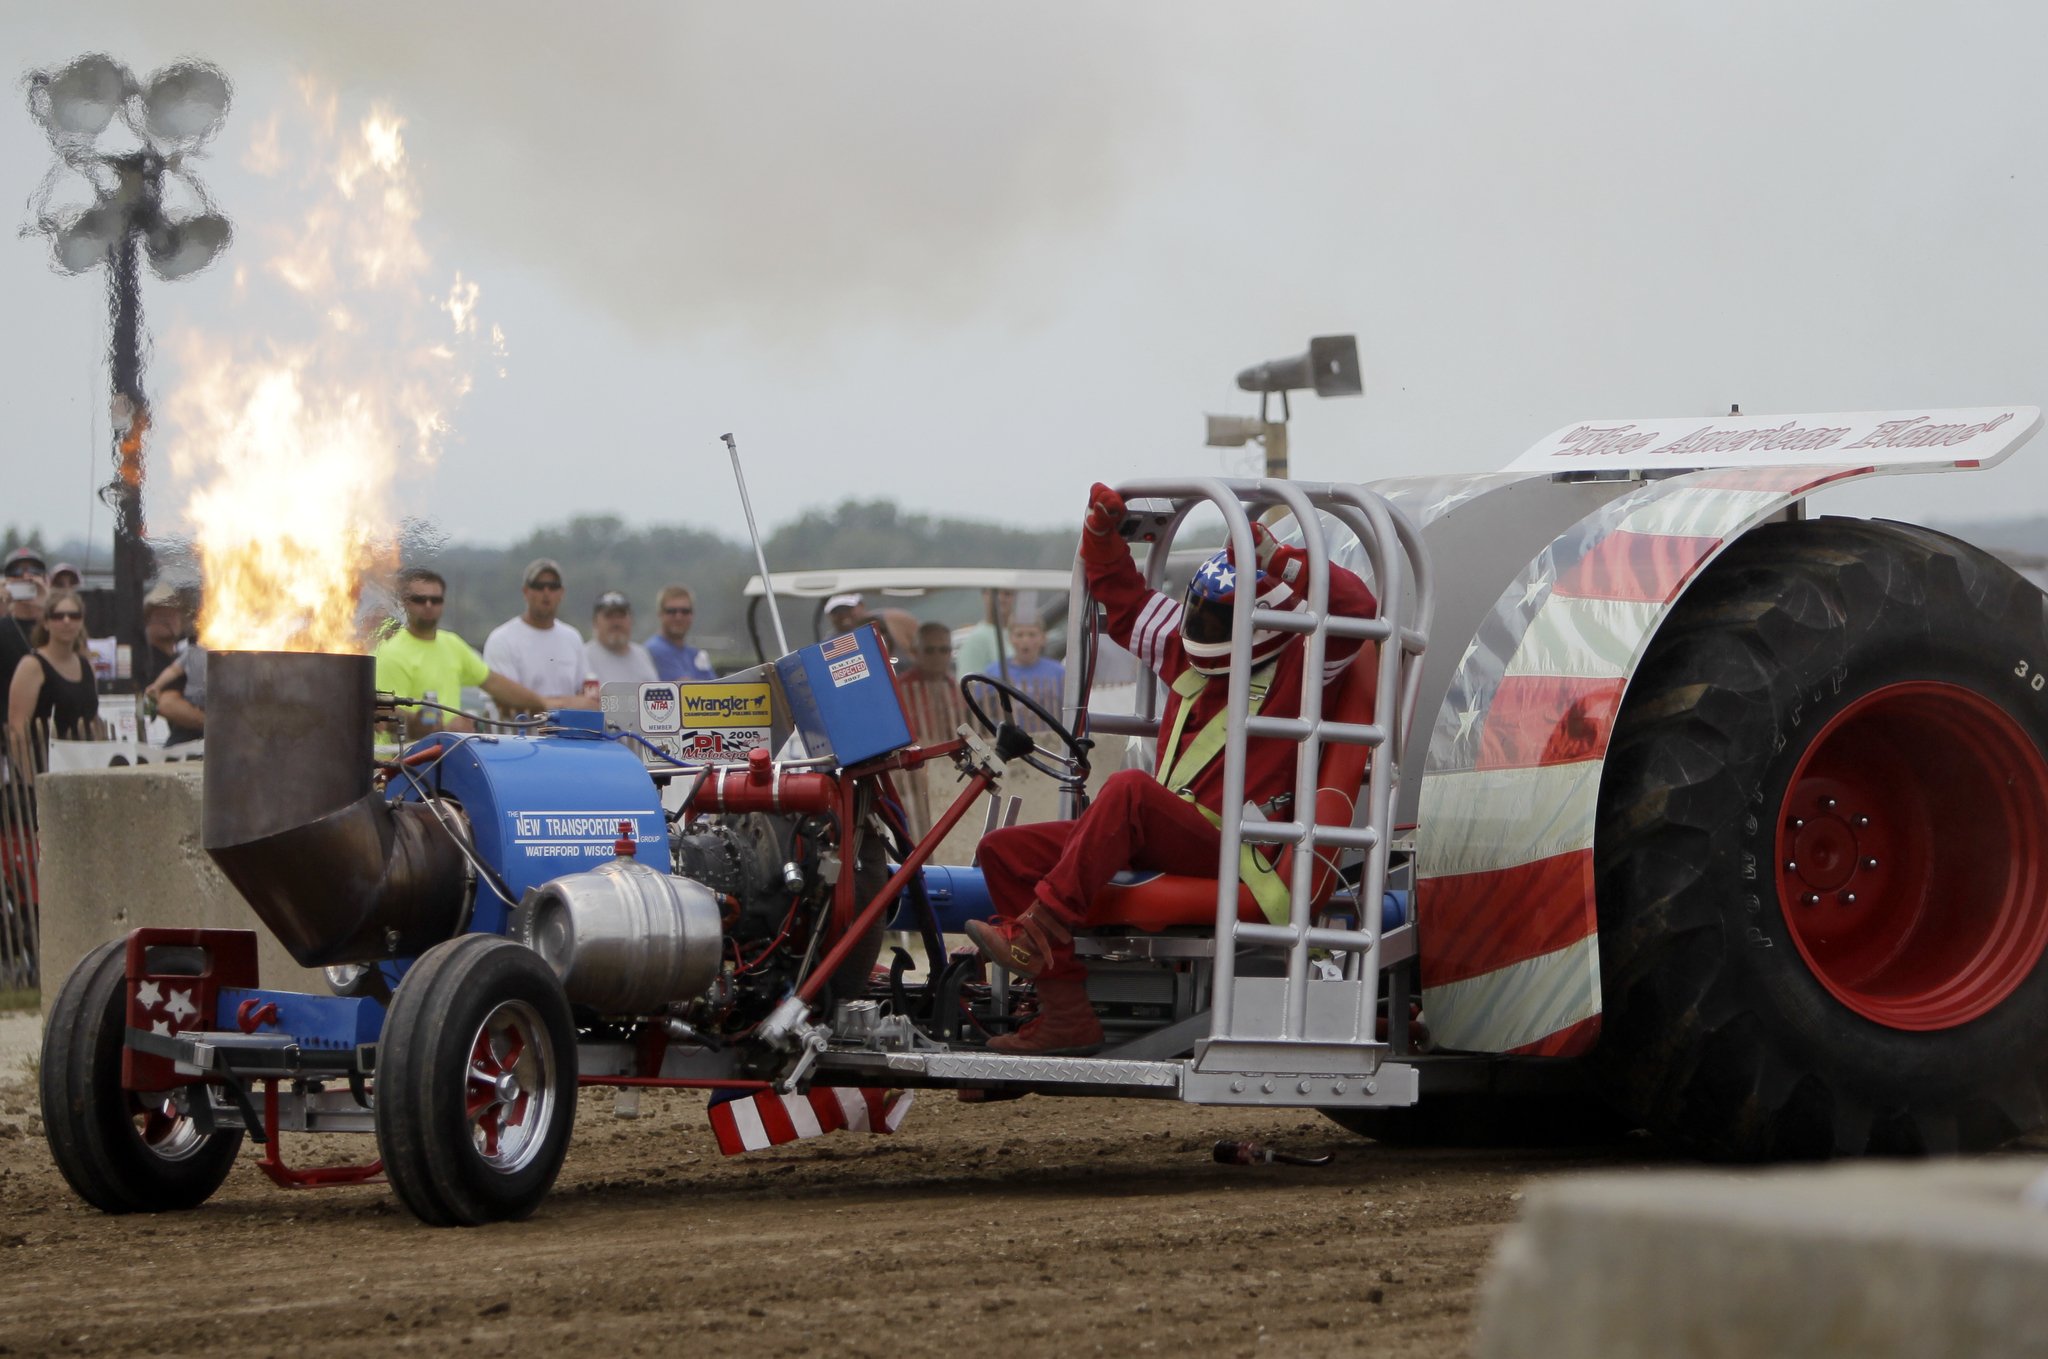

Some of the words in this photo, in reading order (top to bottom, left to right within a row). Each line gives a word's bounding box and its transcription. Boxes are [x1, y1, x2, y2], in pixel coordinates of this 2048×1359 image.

[1648, 420, 1852, 455] American
[832, 662, 867, 680] INSPECTED
[650, 700, 669, 711] NTPA
[684, 695, 749, 718] Wrangler
[694, 734, 723, 753] PI
[729, 731, 760, 739] 2005
[683, 747, 750, 762] Motorspo
[516, 819, 540, 836] NEW
[525, 846, 580, 857] WATERFORD
